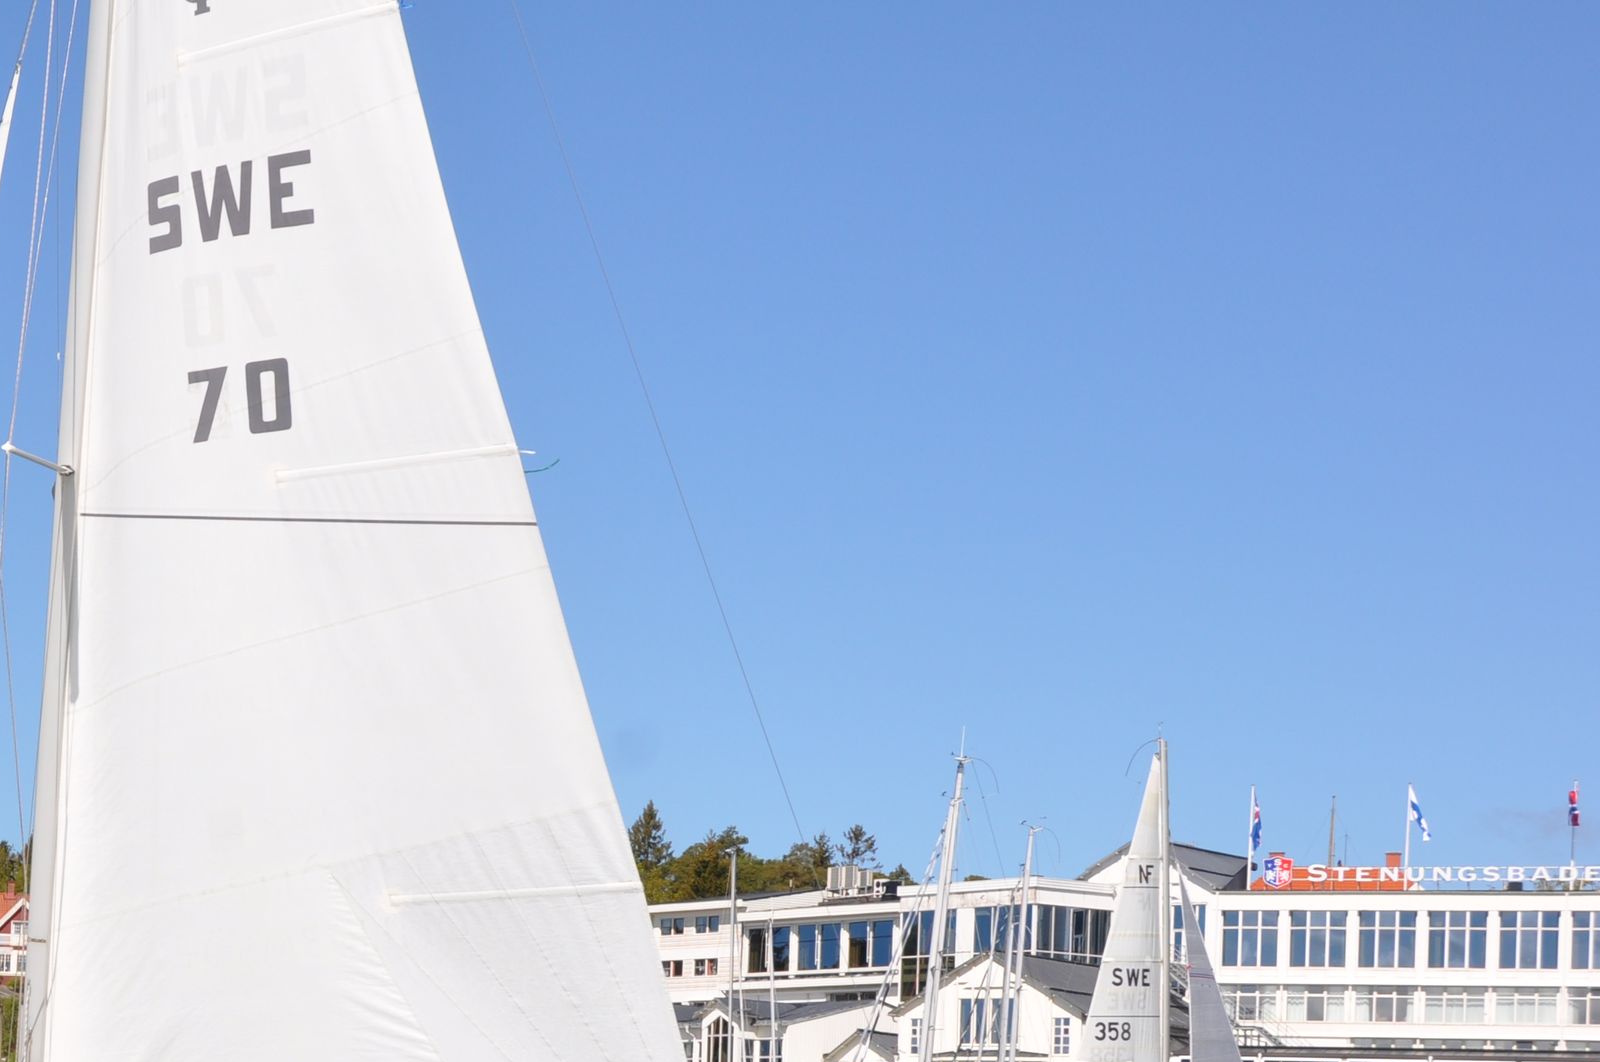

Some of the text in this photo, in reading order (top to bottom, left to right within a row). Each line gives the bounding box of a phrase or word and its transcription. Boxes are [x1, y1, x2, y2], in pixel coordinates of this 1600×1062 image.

[147, 149, 315, 255] SWE
[187, 357, 292, 444] 70
[1111, 967, 1151, 987] SWE
[1094, 1021, 1132, 1042] 358
